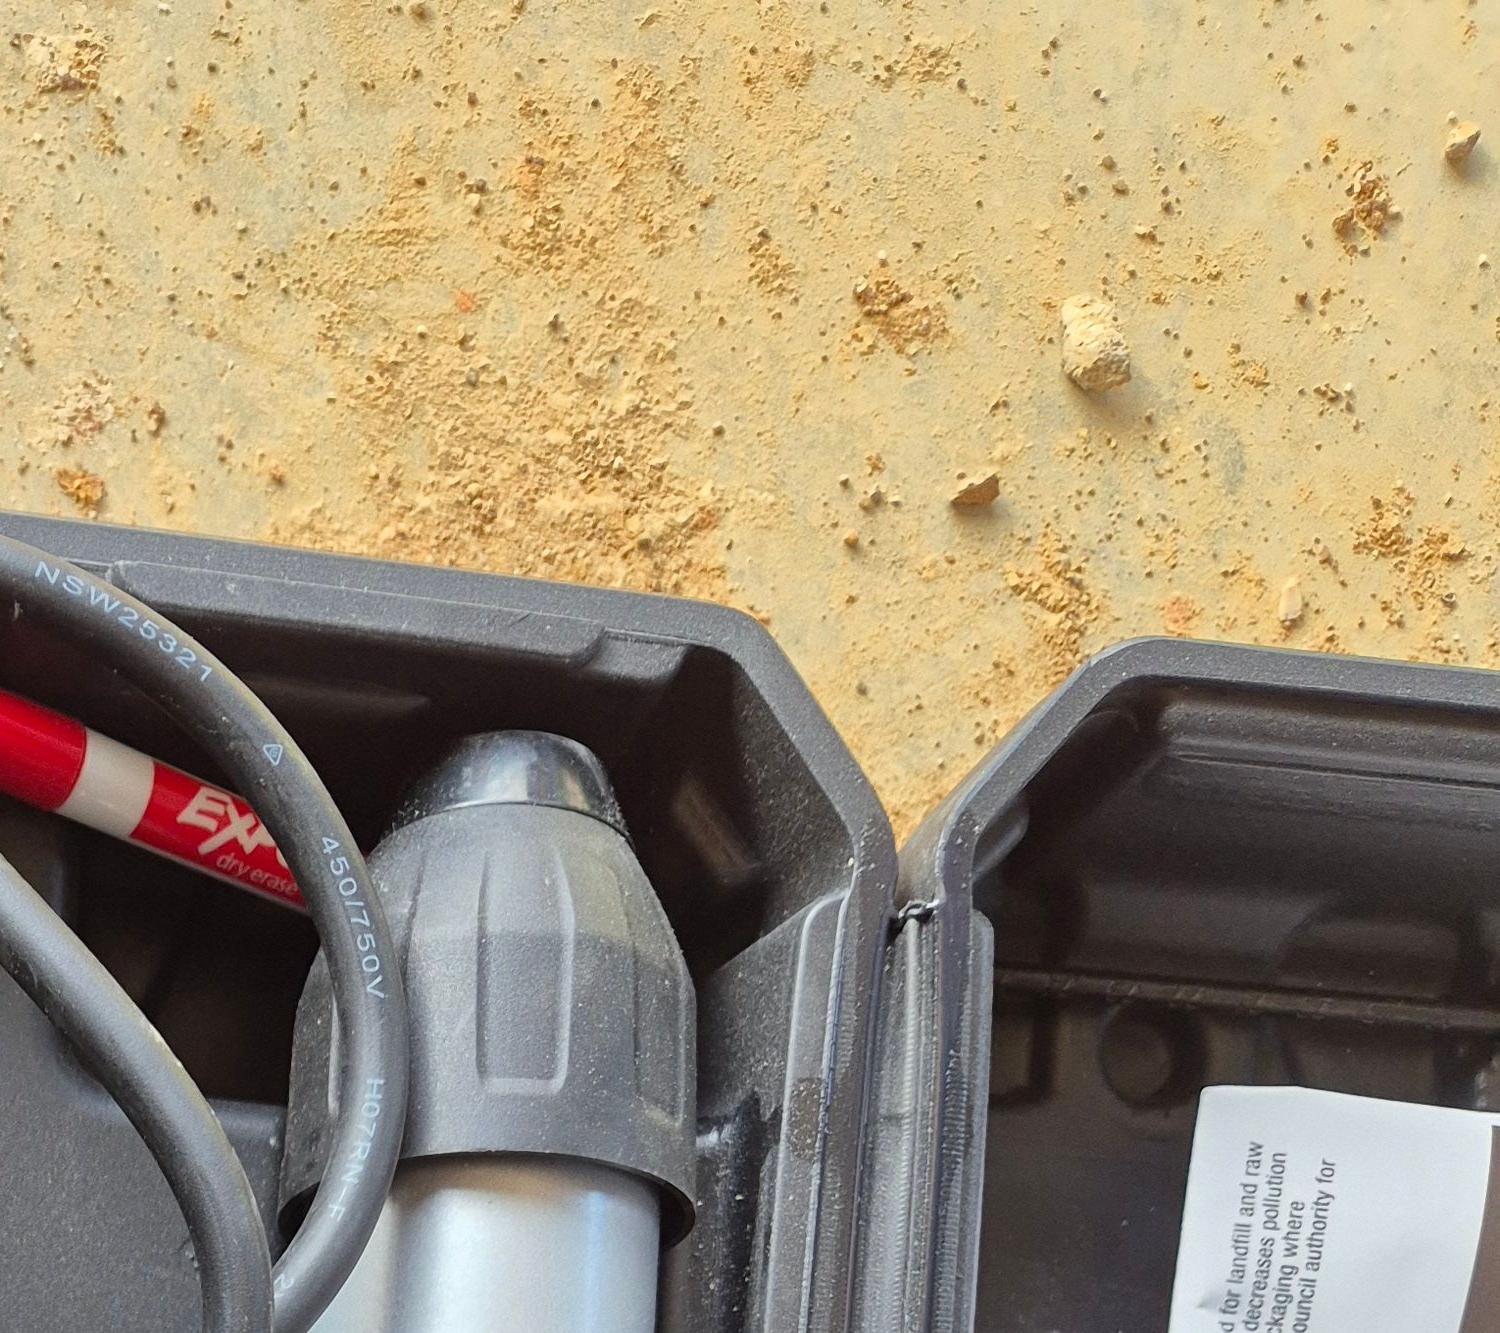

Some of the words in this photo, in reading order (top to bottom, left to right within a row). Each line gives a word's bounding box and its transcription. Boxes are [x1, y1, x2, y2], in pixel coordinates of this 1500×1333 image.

[34, 559, 214, 683] NSW25321
[216, 852, 250, 879] dry
[321, 835, 388, 1000] 450/750V
[326, 1077, 386, 1223] H07RN-F
[1244, 1141, 1264, 1178] raw
[1314, 1158, 1337, 1185] for
[1238, 1182, 1259, 1217] and
[1282, 1200, 1306, 1258] where
[1225, 1222, 1252, 1284] landfill
[1243, 1236, 1275, 1331] decreases
[1261, 1151, 1287, 1231] pollution
[1301, 1190, 1336, 1273] authority
[1219, 1289, 1241, 1315] for
